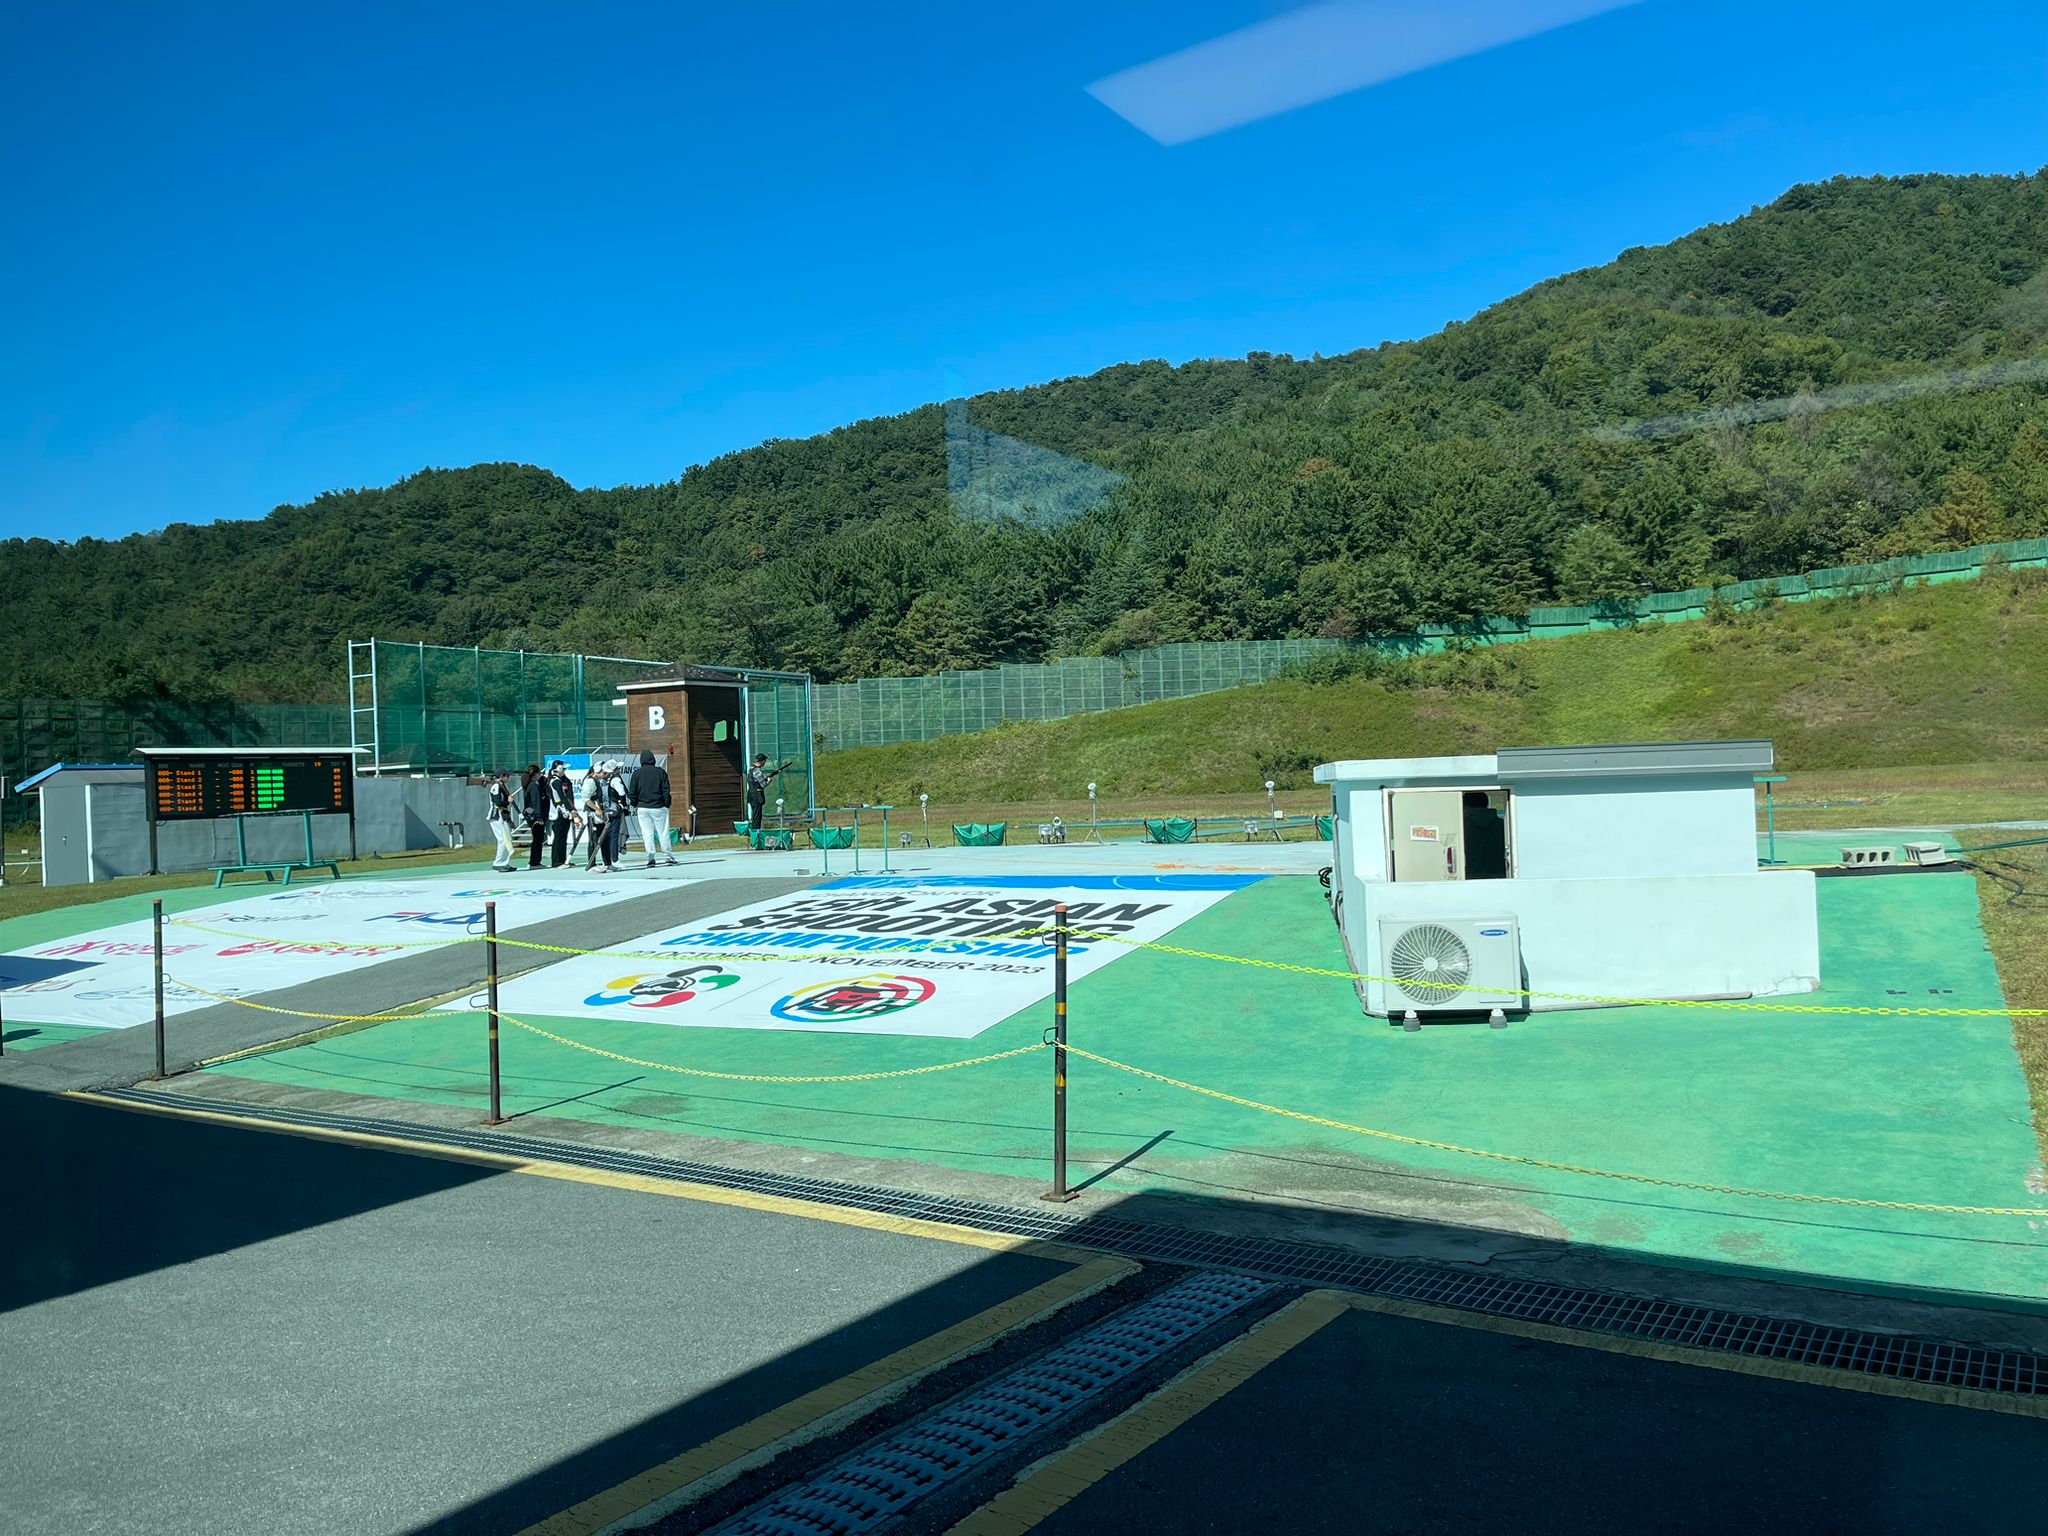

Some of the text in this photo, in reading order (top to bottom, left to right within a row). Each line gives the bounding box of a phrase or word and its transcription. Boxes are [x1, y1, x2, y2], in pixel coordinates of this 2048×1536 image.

[649, 706, 665, 730] B
[765, 896, 1174, 921] 15th ASIAN
[707, 913, 1136, 943] SHOOTING
[660, 932, 1089, 959] CHAMPIONSHIP
[809, 956, 975, 970] NOVEMBER
[974, 963, 1046, 974] 2023
